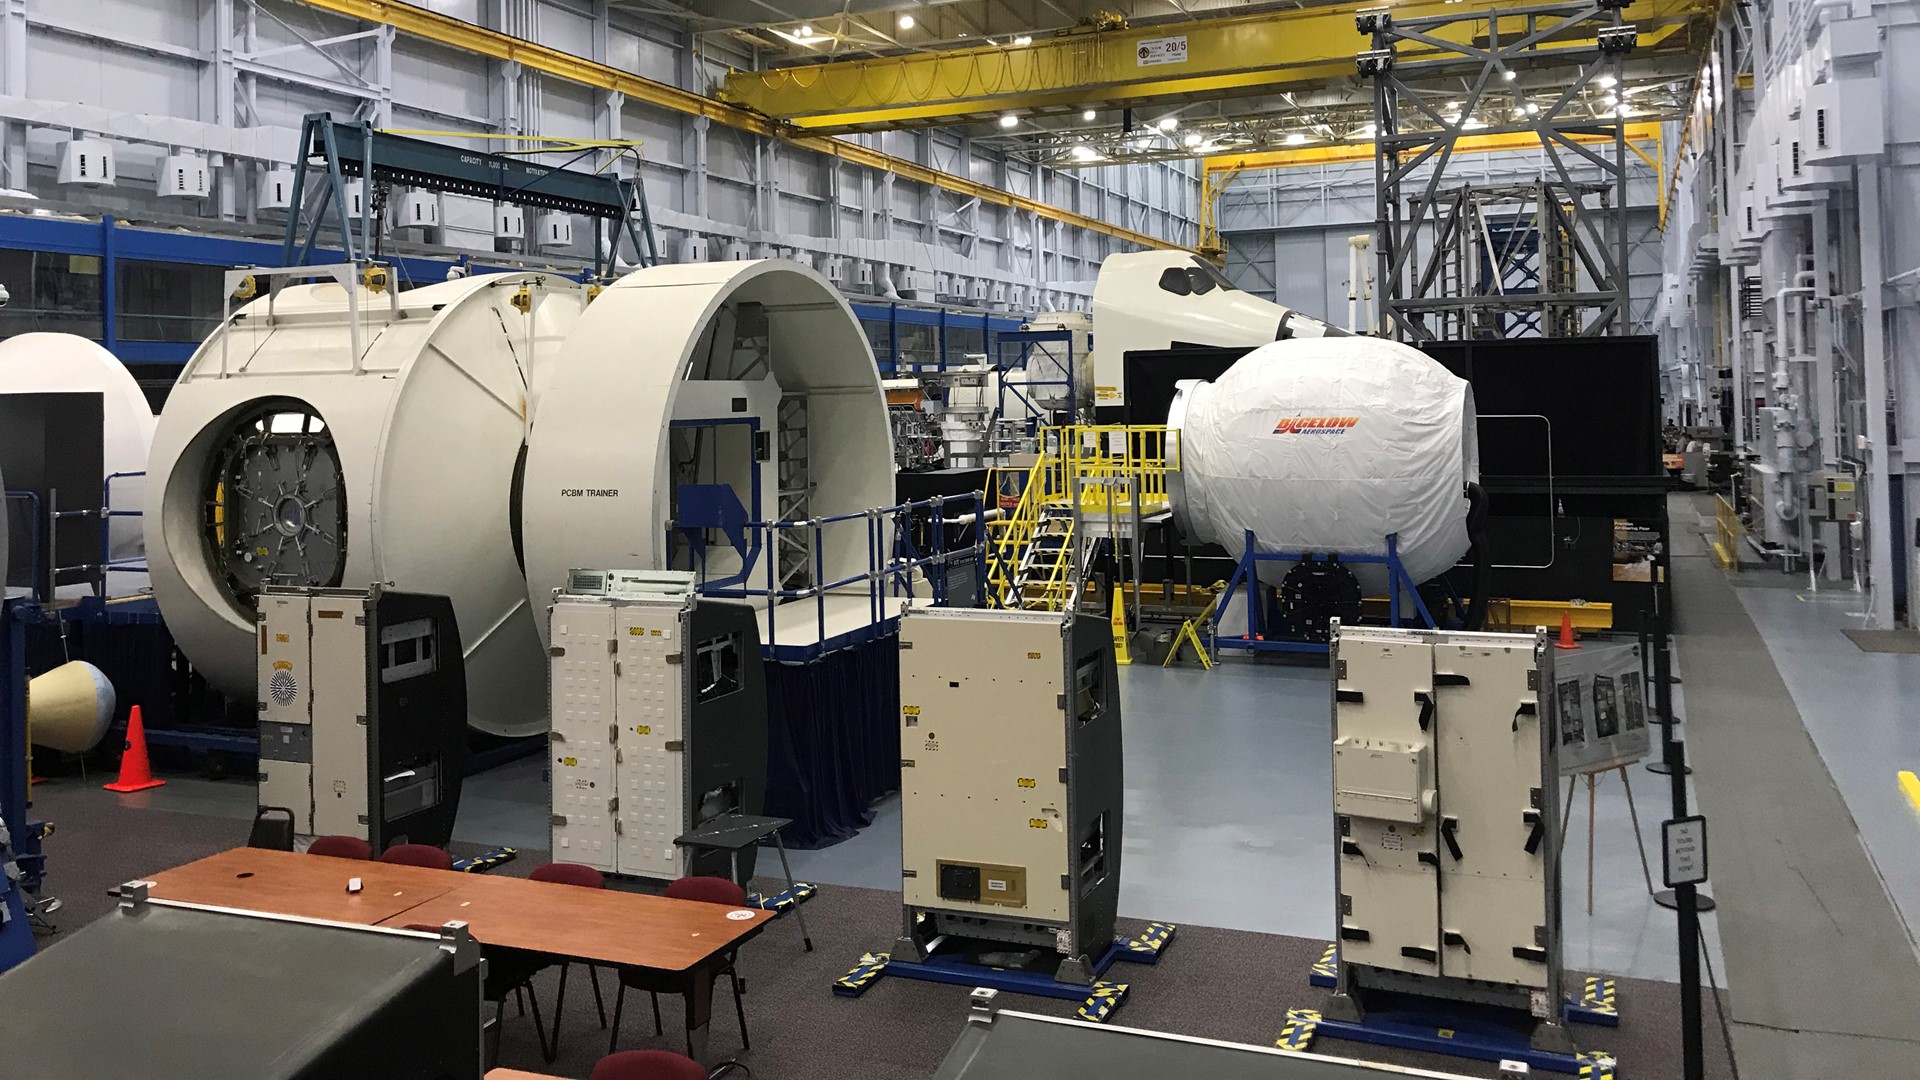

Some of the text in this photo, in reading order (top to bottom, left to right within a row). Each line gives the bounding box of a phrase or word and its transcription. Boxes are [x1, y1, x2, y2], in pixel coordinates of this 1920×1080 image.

[1166, 41, 1186, 52] 20/5
[460, 155, 482, 166] CAPACITY
[1273, 416, 1360, 433] BIGELOW
